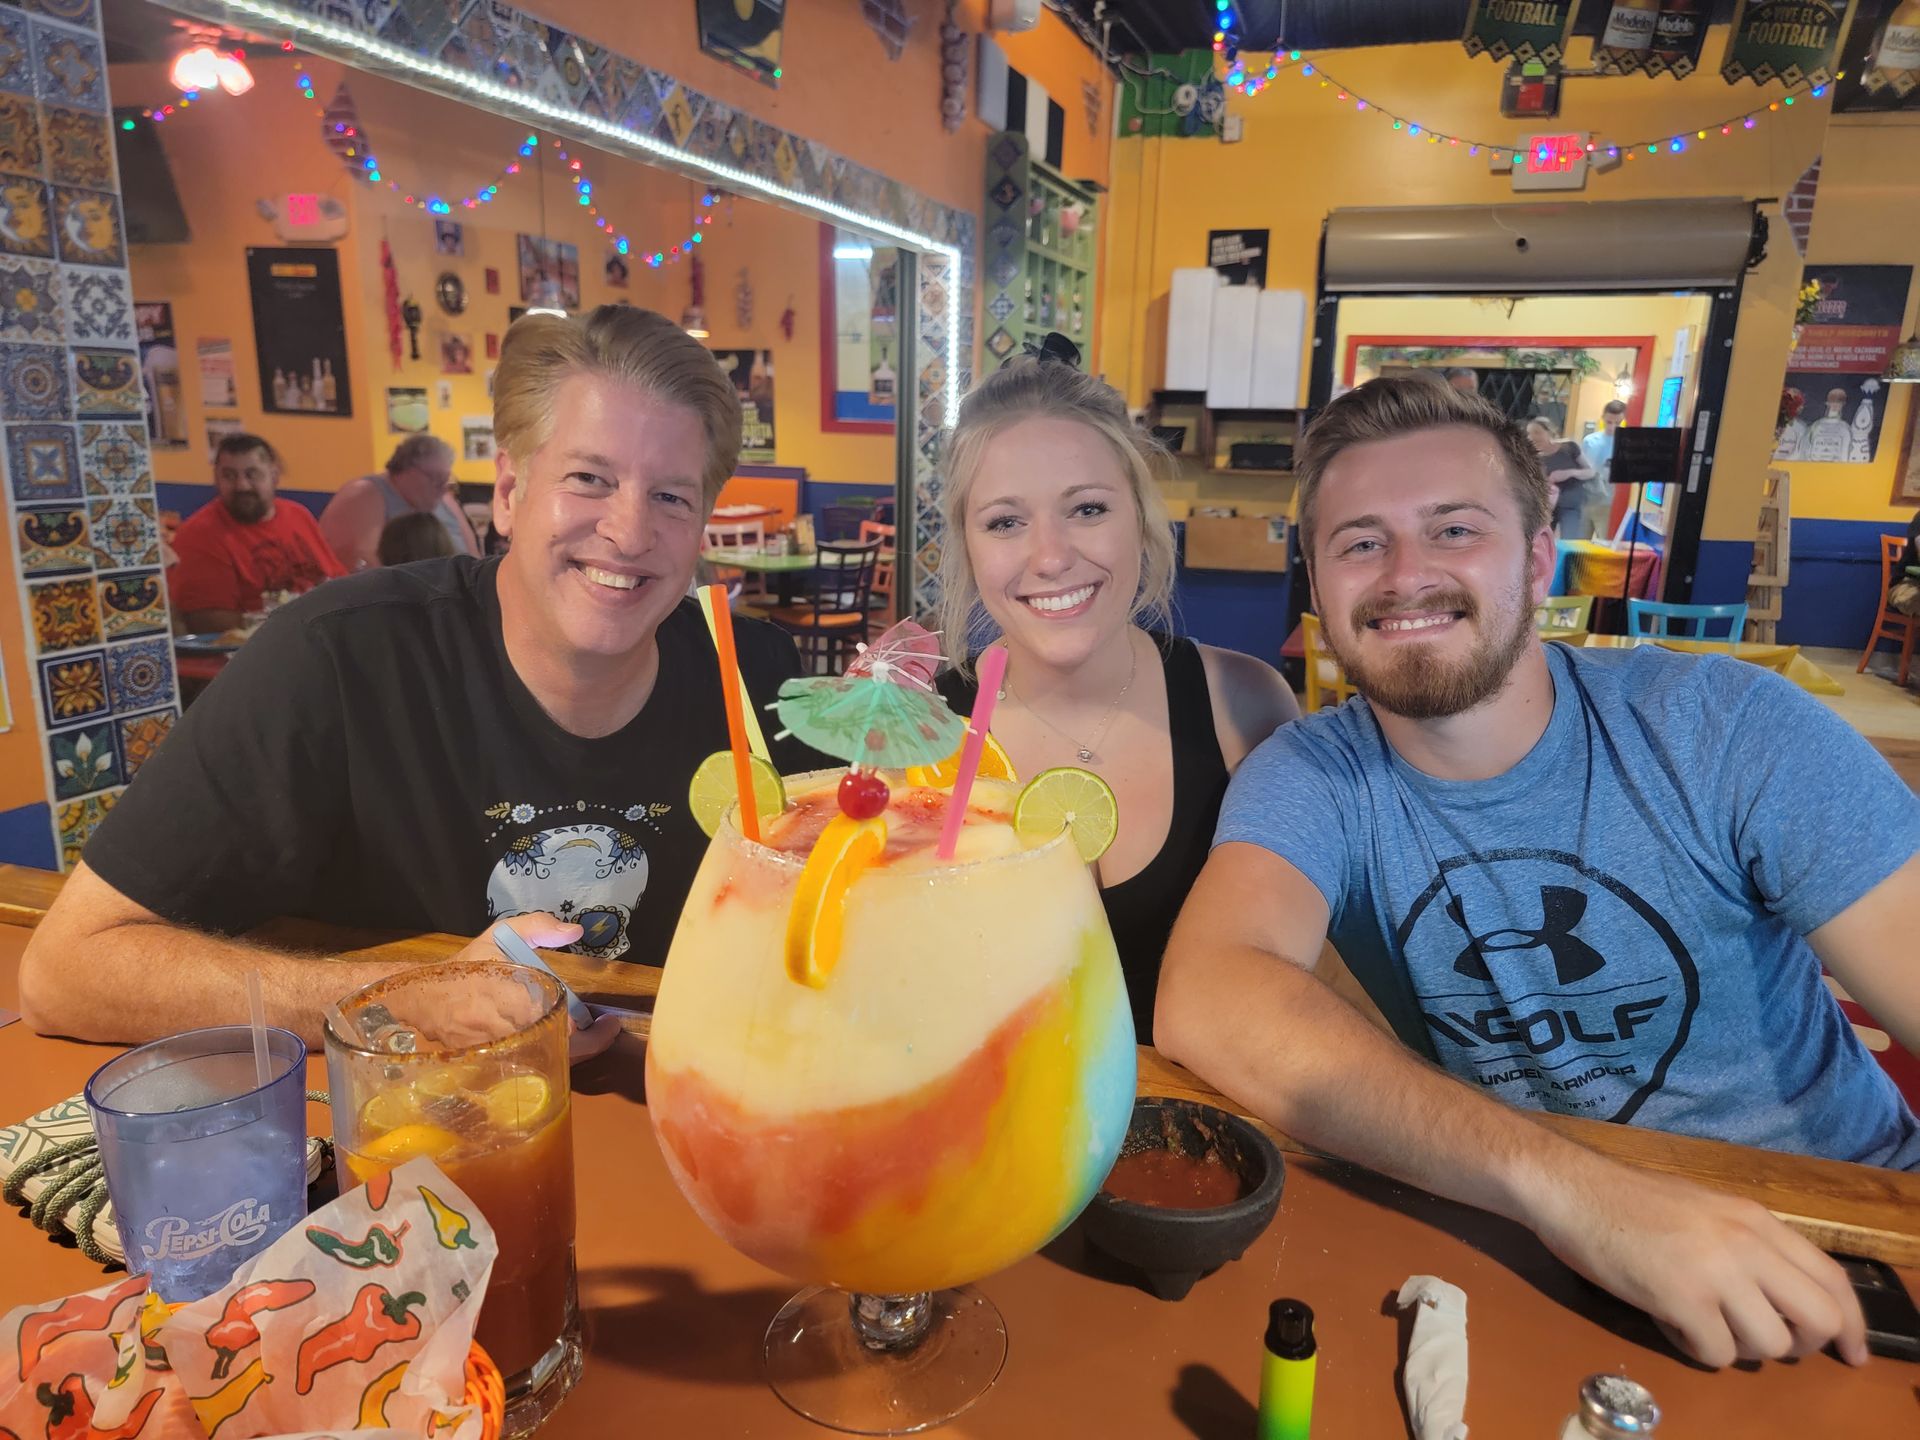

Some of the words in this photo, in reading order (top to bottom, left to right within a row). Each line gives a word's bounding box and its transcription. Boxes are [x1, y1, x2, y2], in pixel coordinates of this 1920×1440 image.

[1486, 0, 1558, 26] FOOTBALL
[1612, 11, 1654, 29] Modelo
[1657, 16, 1696, 33] Modelo
[1747, 22, 1829, 49] FOOTBALL
[1527, 135, 1578, 173] EXIT
[1470, 995, 1669, 1055] GOLF
[1550, 1064, 1638, 1092] ARMOUR
